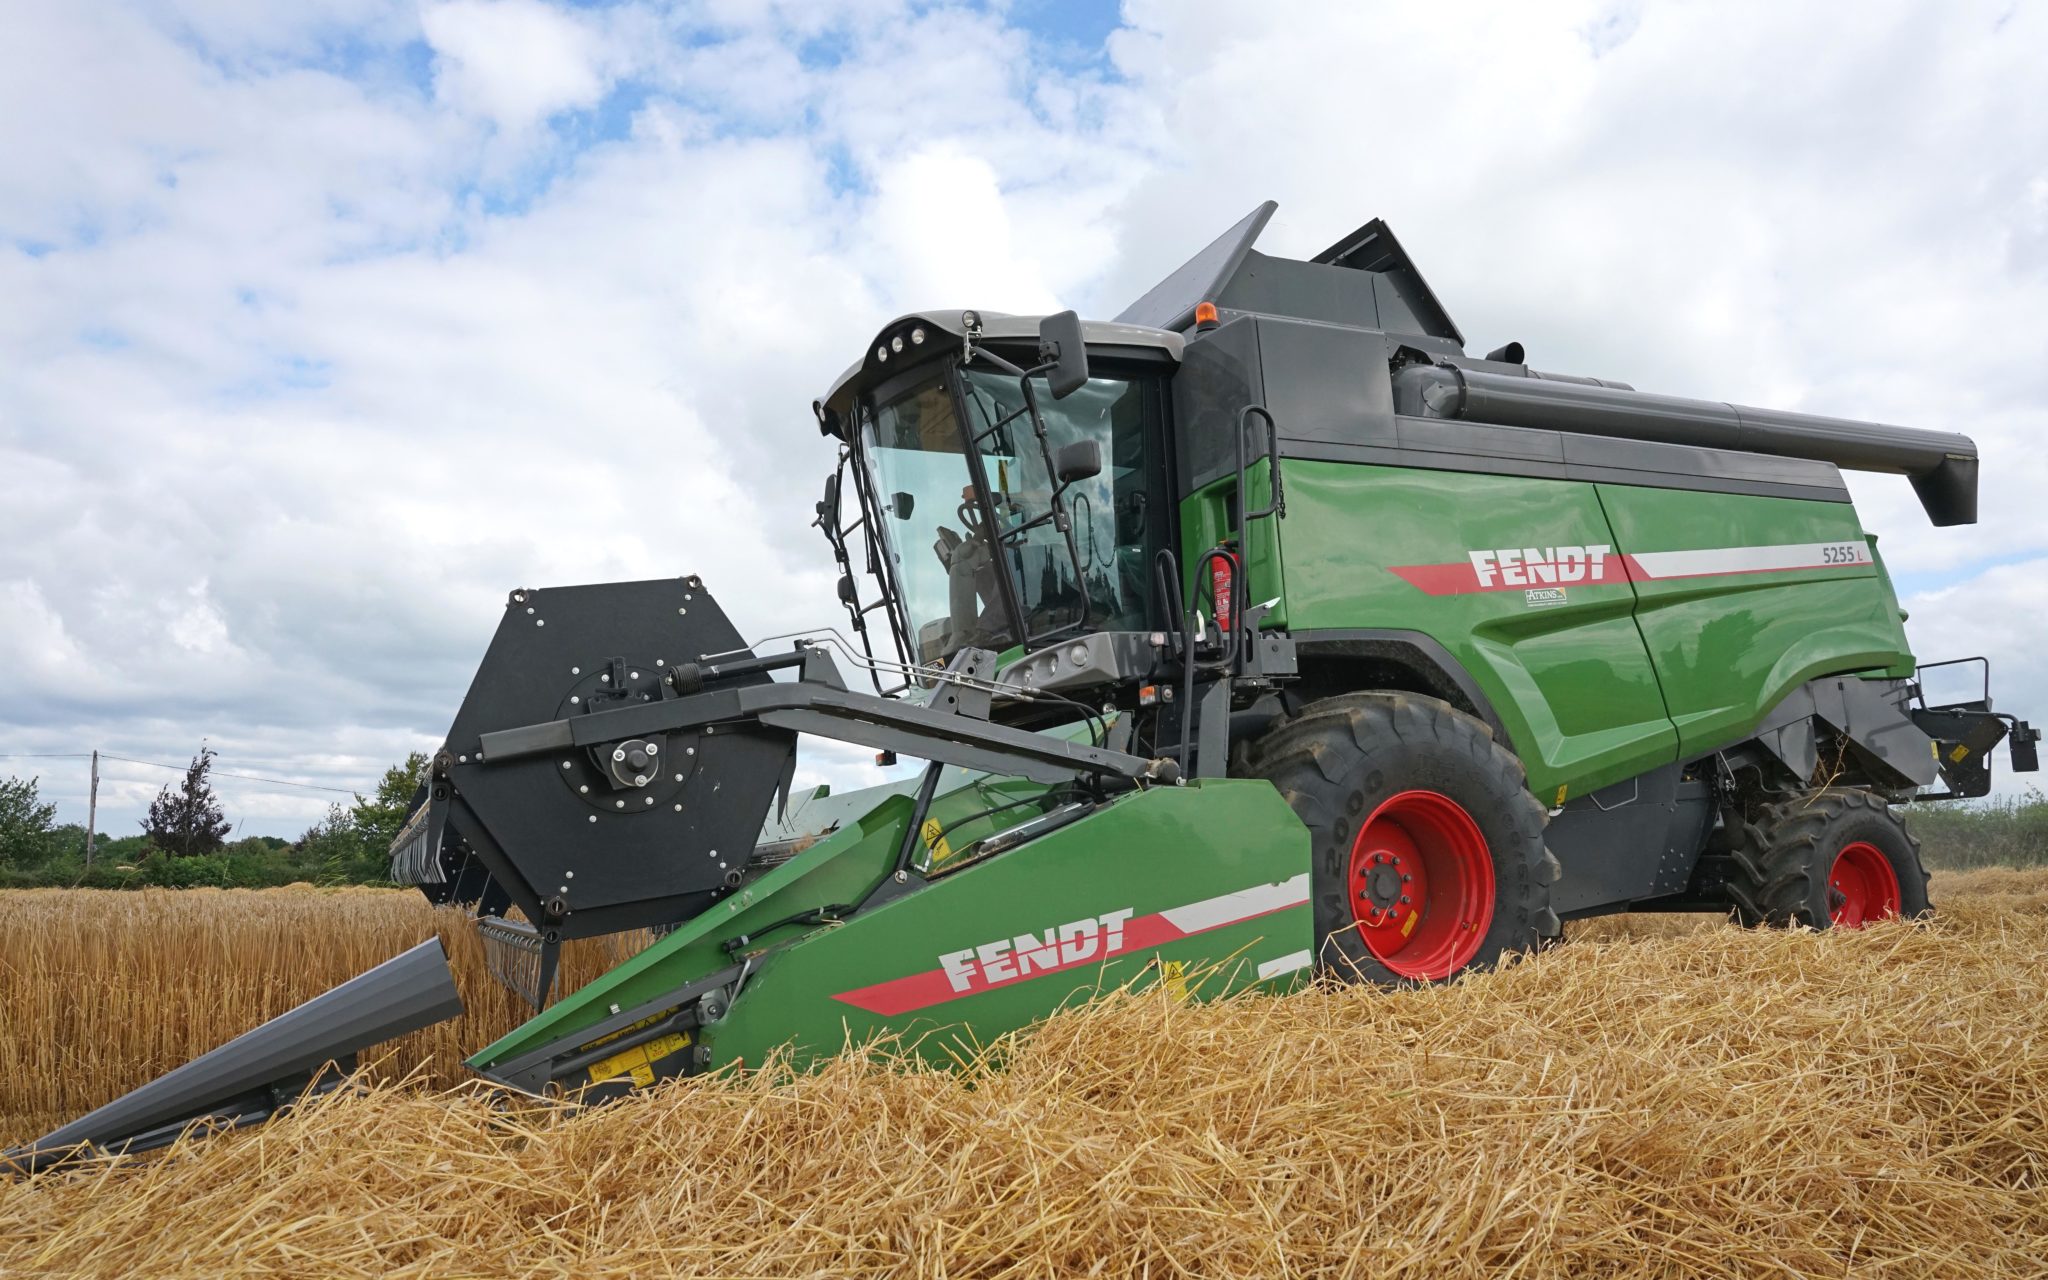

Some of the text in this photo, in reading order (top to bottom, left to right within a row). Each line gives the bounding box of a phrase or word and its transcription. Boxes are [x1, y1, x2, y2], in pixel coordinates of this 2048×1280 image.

[1468, 545, 1611, 588] FENDT
[1823, 546, 1864, 564] 5255 L
[937, 906, 1134, 994] FENDT
